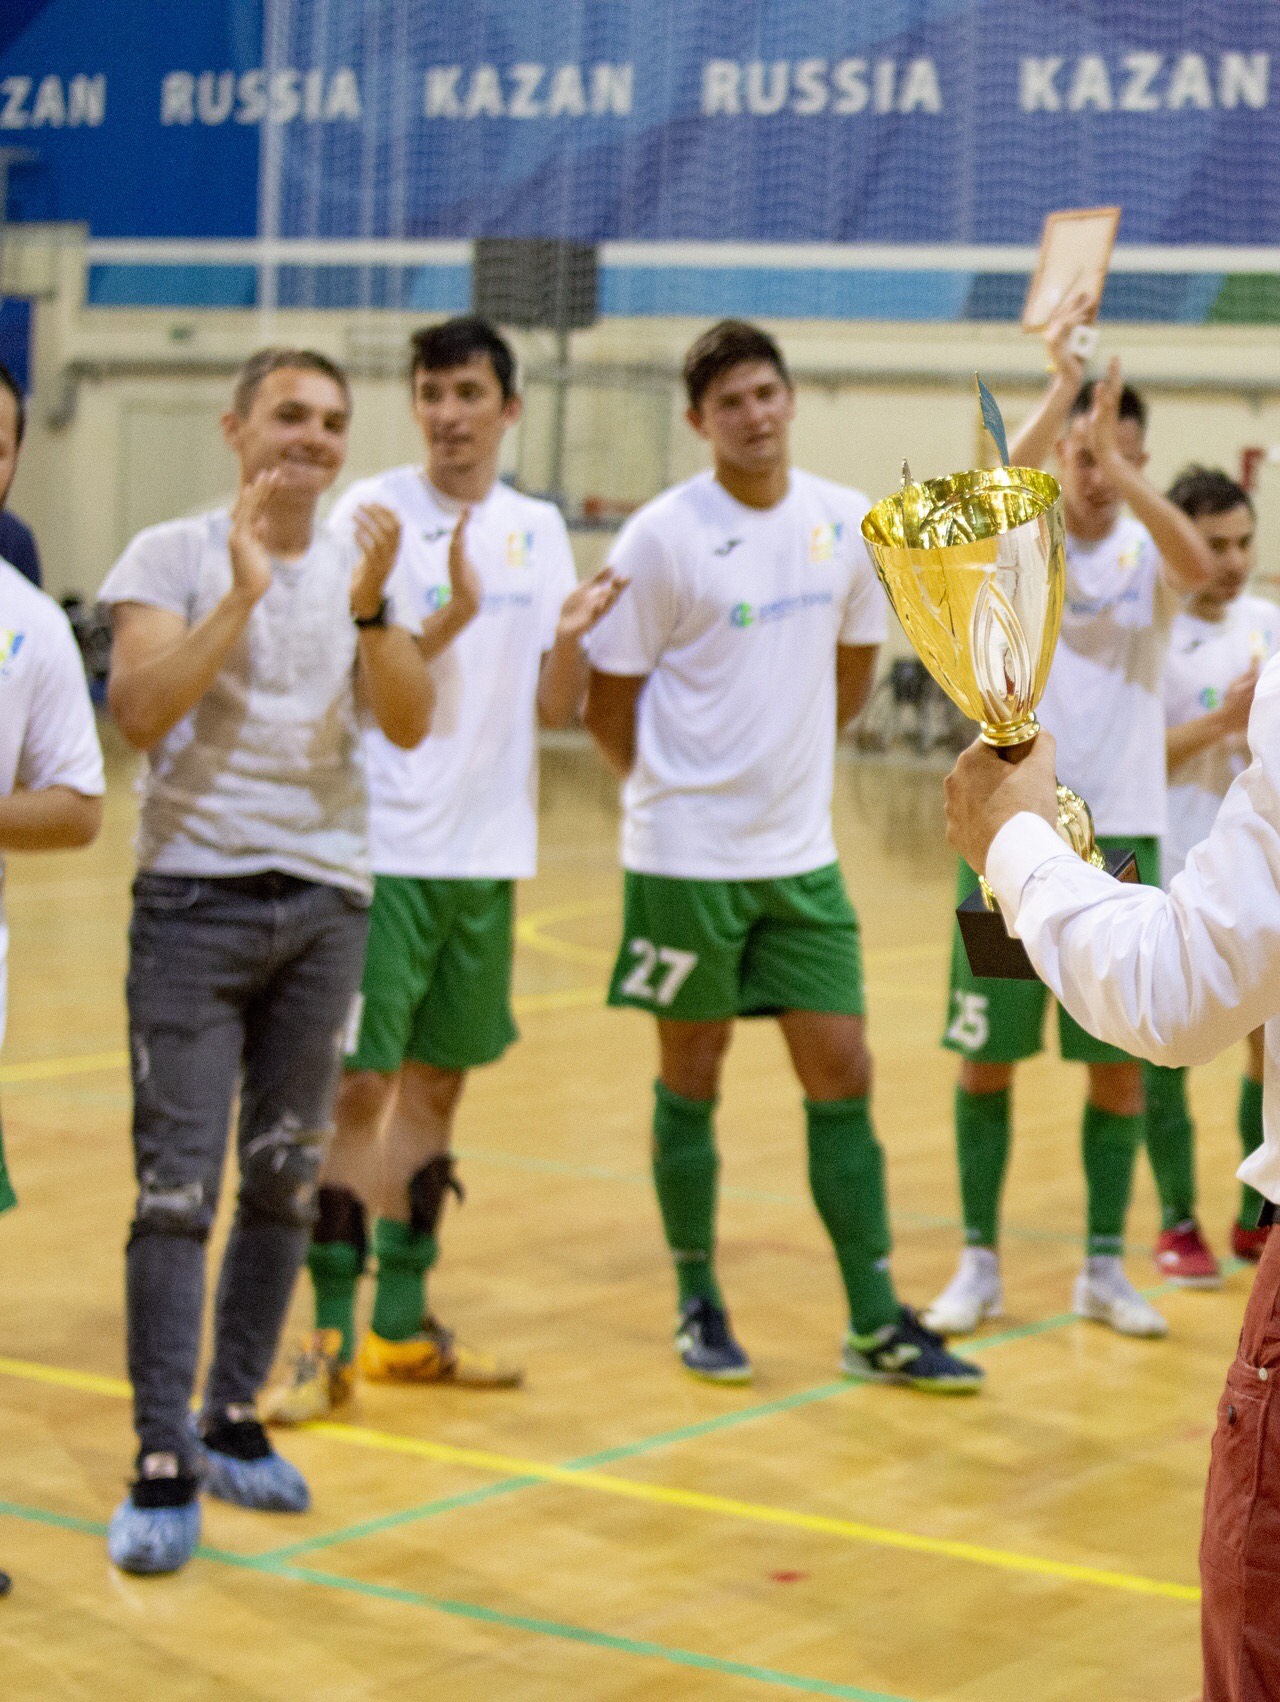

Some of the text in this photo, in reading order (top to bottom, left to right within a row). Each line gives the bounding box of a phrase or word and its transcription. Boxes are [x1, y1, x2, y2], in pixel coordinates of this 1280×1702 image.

[161, 69, 361, 126] RUSSIA
[425, 65, 634, 118] KAZAN
[702, 60, 942, 114] RUSSIA
[1020, 53, 1270, 111] KAZAN
[621, 939, 698, 1007] 27
